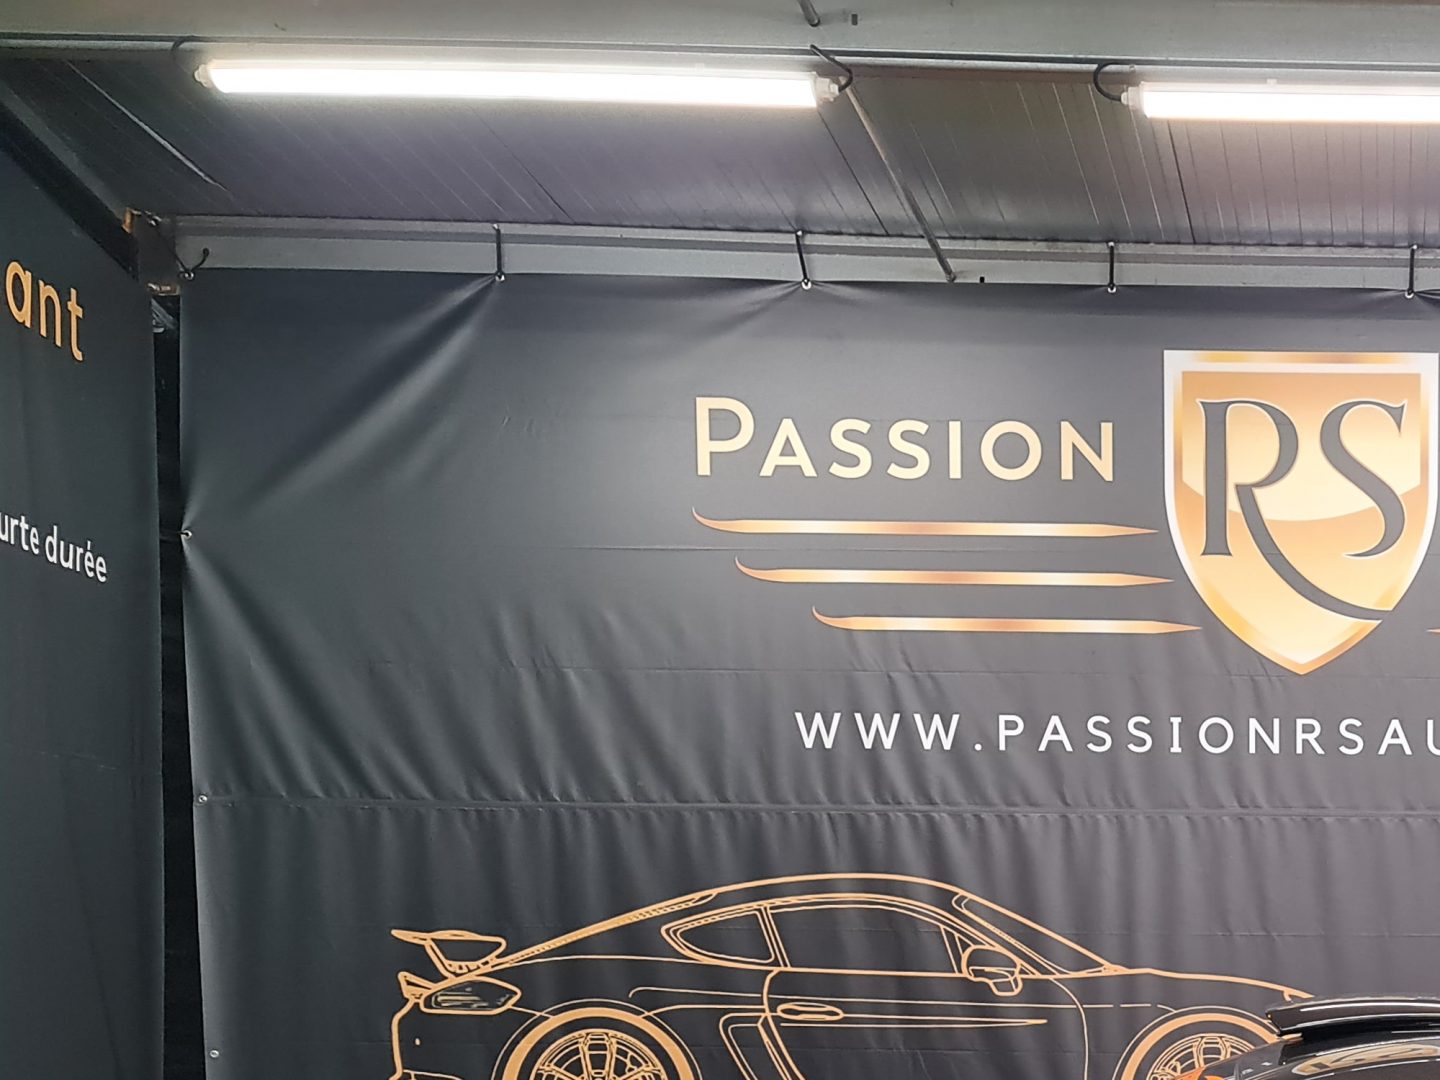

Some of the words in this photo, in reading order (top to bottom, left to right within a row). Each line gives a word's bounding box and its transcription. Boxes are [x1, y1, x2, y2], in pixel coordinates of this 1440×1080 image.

[5, 261, 84, 362] ant
[45, 525, 107, 582] durée
[694, 396, 1115, 482] PASSION
[1195, 398, 1409, 622] RS
